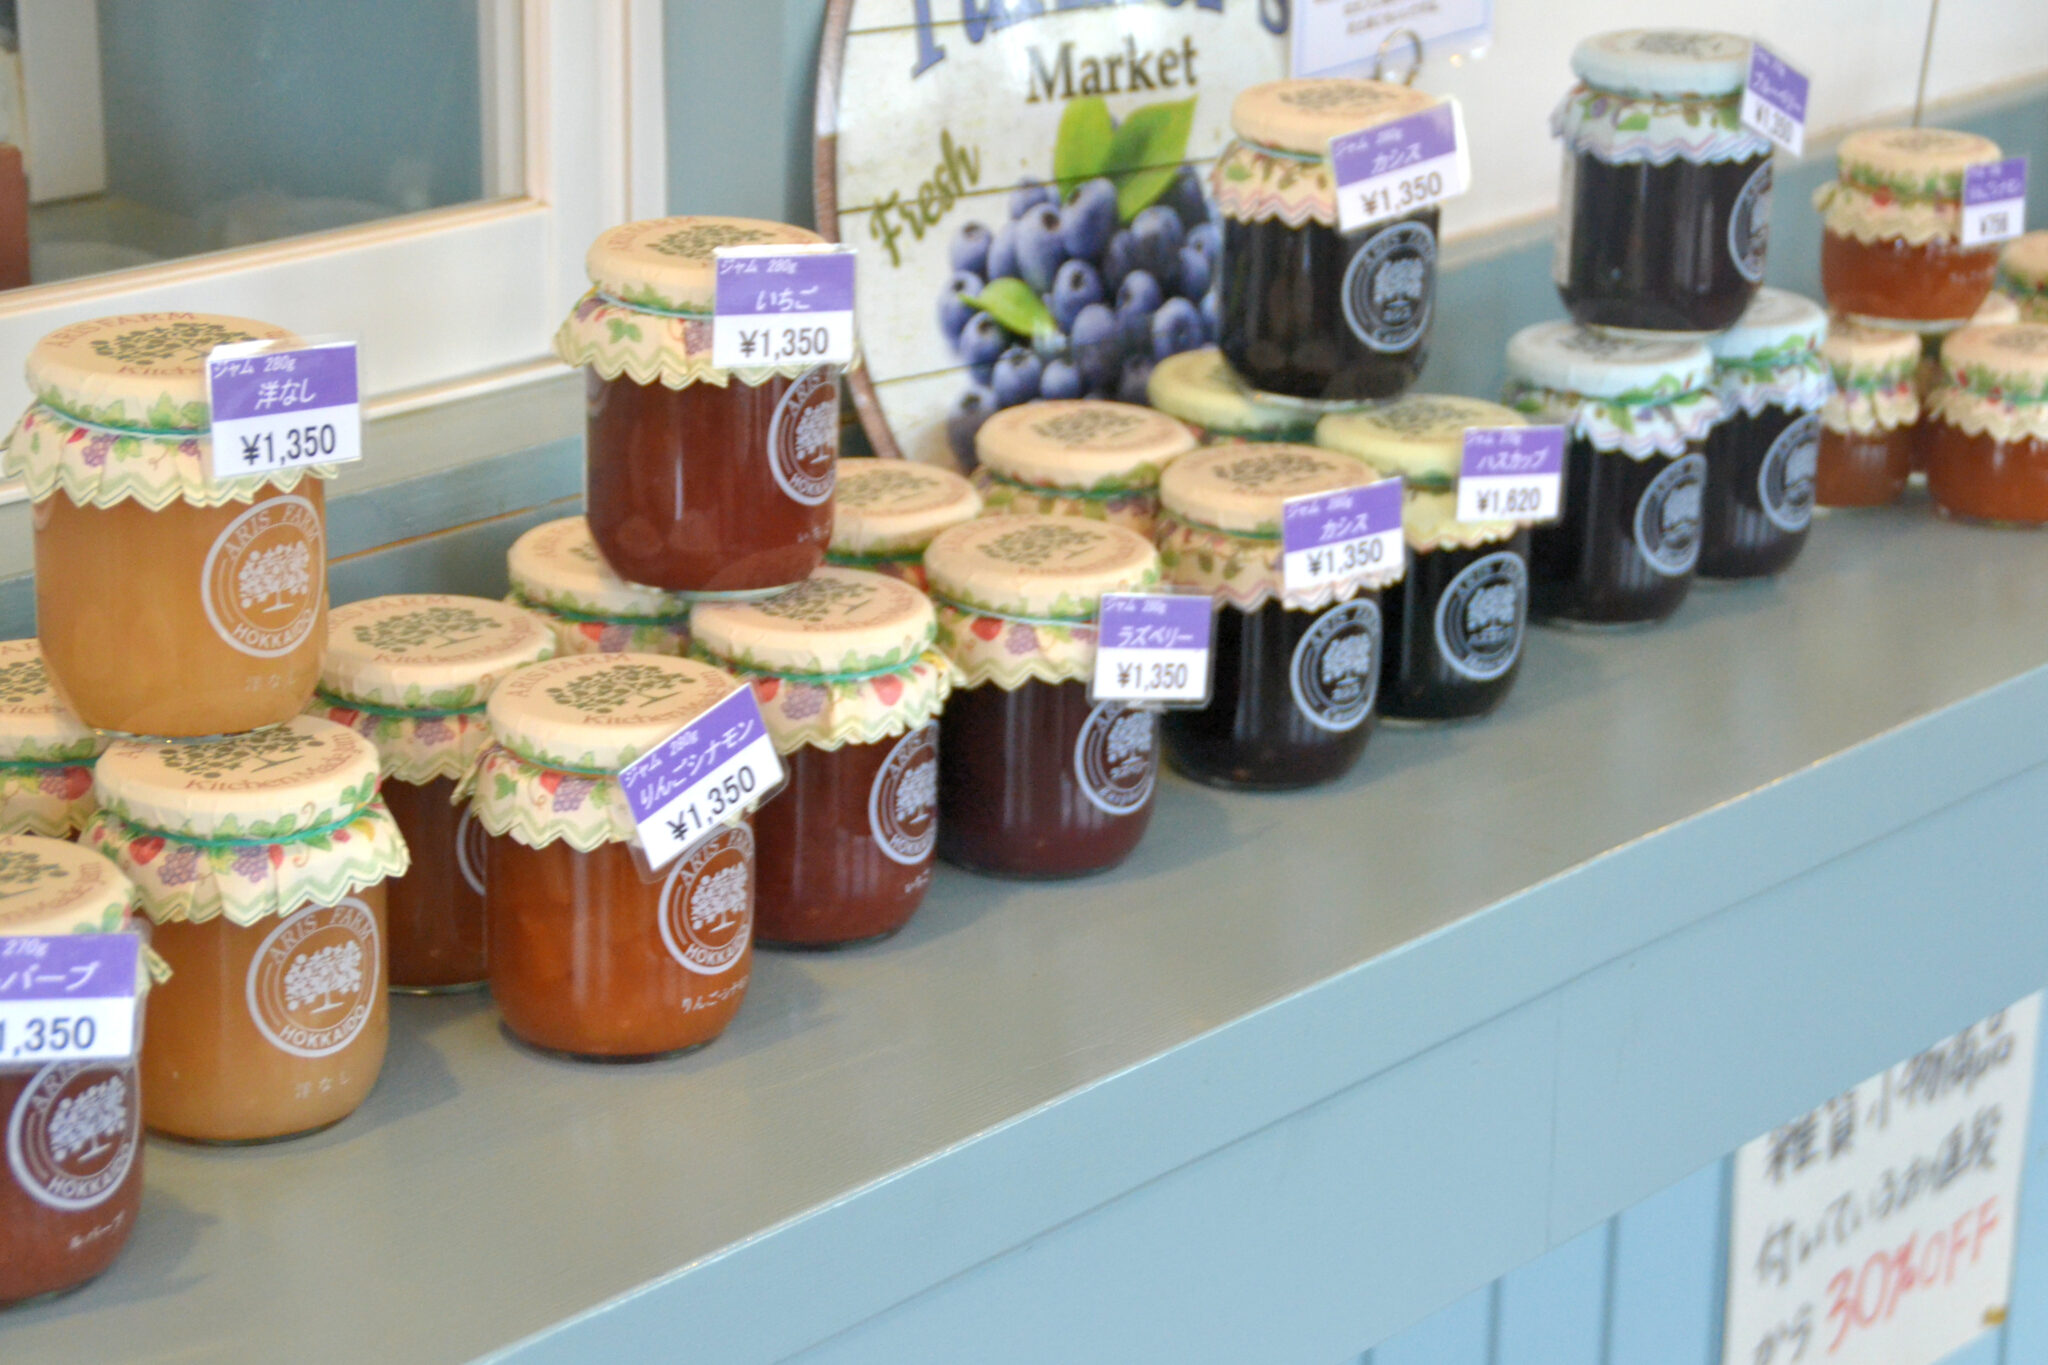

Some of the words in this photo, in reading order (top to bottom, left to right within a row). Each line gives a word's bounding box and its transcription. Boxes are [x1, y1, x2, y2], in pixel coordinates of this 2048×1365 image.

[1025, 36, 1198, 103] Market
[1371, 142, 1422, 175] カシス
[869, 128, 980, 268] Fresh
[1360, 171, 1443, 215] ¥1,350
[755, 285, 819, 312] いちご
[739, 327, 830, 360] ¥1,350
[213, 355, 255, 379] ジャム
[263, 355, 298, 373] 280g
[254, 378, 317, 412] 洋なし
[241, 423, 337, 467] ¥1,350
[1475, 447, 1549, 471] ハスカップ
[1476, 486, 1542, 514] ¥1,620
[1319, 512, 1369, 541] カシス
[1306, 537, 1384, 576] ¥1,350
[1117, 624, 1194, 648] ラズベリー
[1116, 661, 1189, 692] ¥1,350
[640, 718, 755, 811] りんごシナモン
[666, 765, 756, 842] ¥1,350
